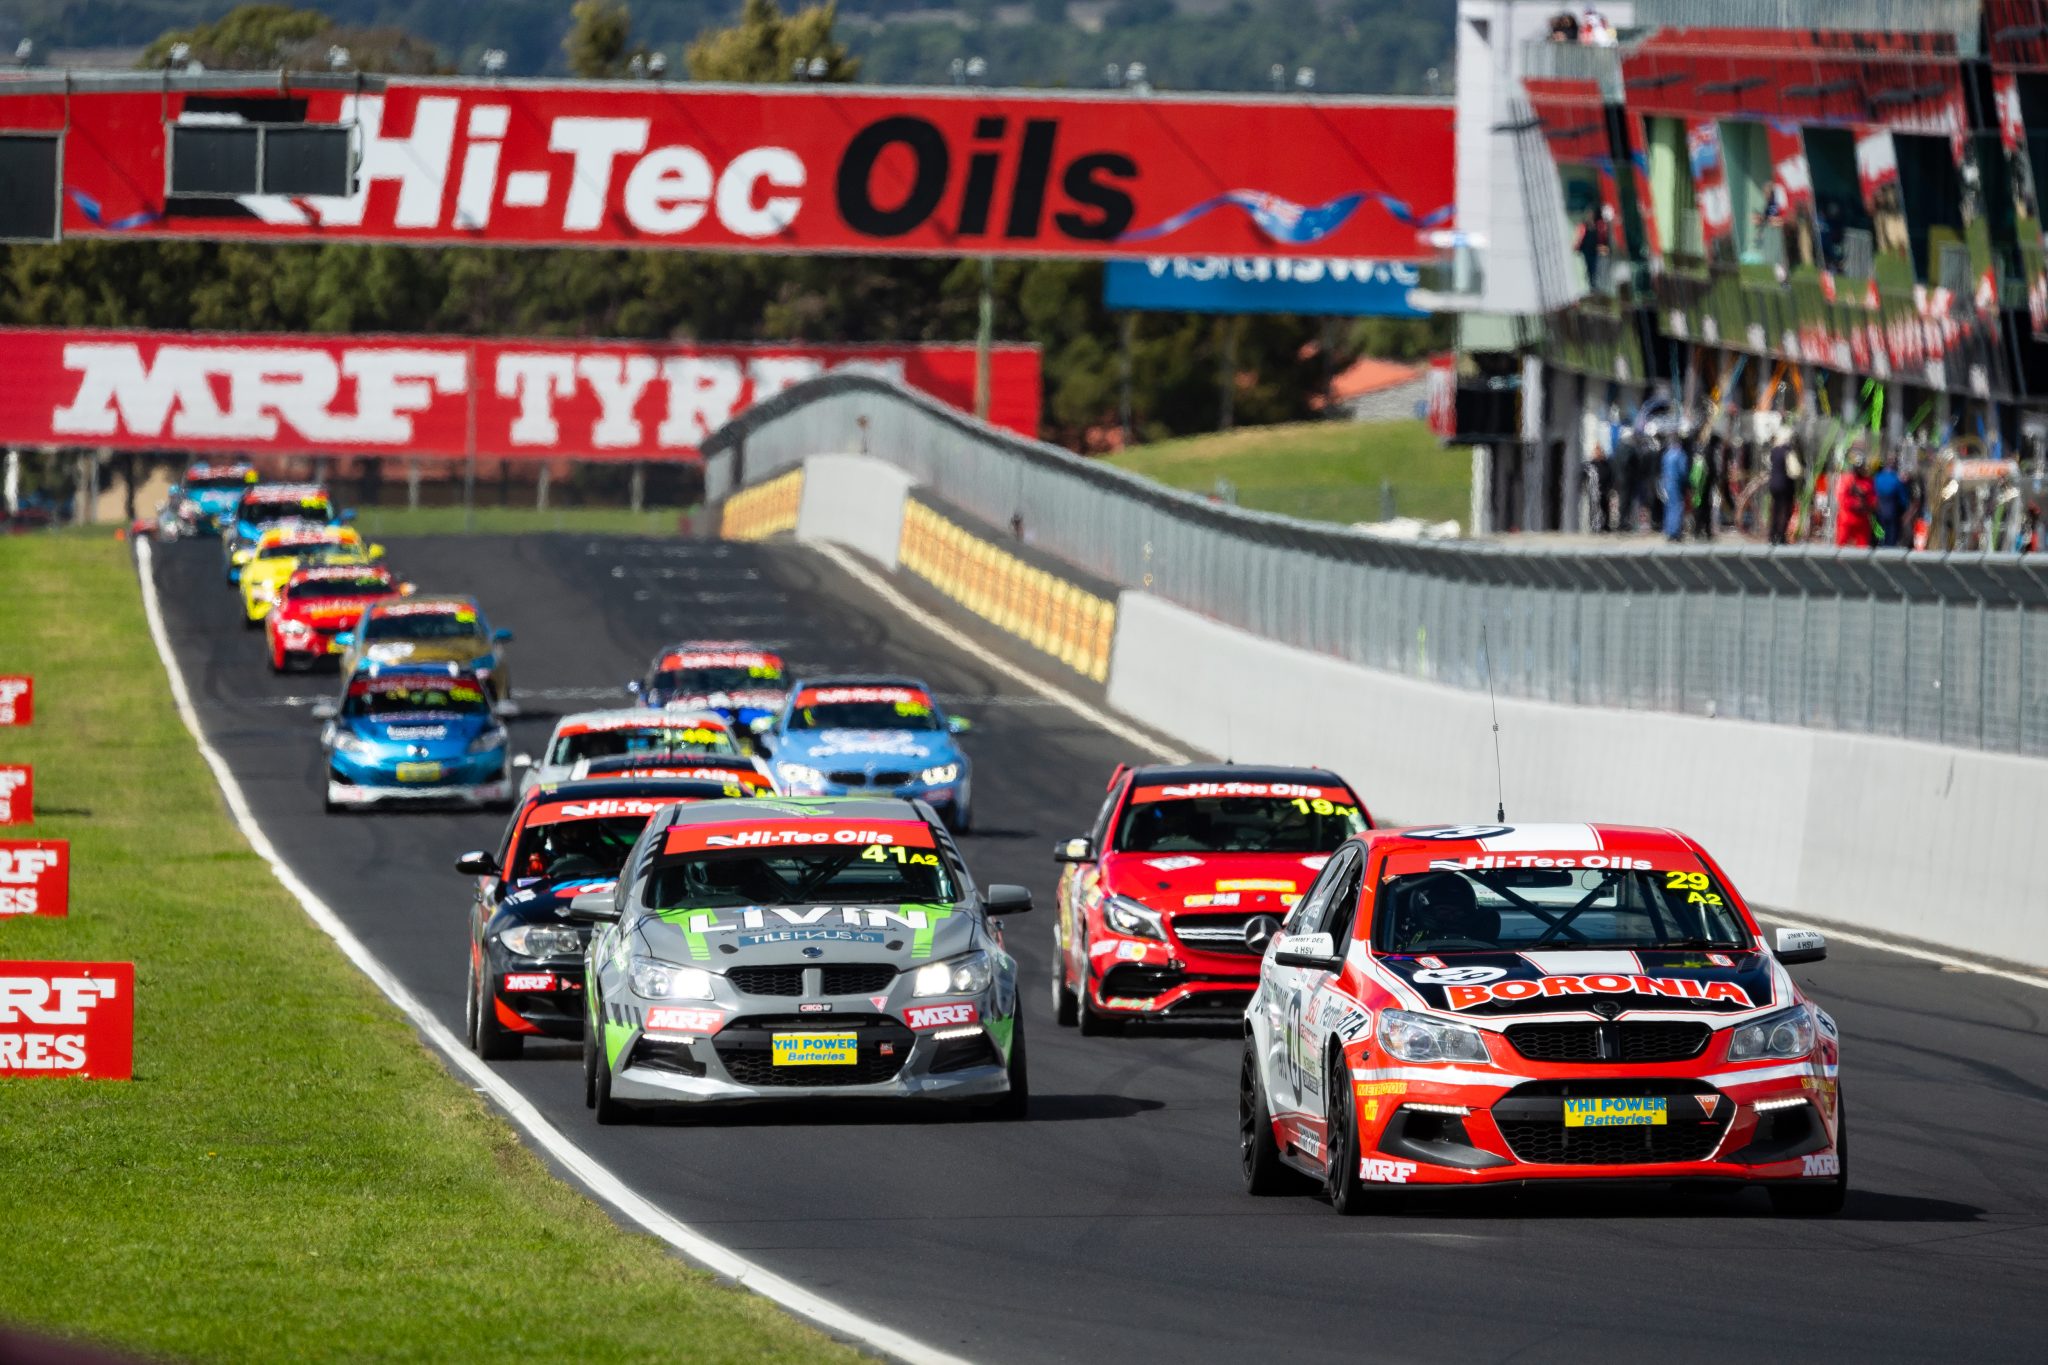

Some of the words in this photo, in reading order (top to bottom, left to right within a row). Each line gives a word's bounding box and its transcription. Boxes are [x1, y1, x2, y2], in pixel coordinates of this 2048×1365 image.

[325, 94, 806, 240] Hi-Tec
[836, 114, 1139, 242] Oils
[53, 342, 468, 444] MRF
[496, 353, 904, 448] TYR
[1187, 782, 1268, 796] Hi-Tec
[1270, 783, 1322, 798] Oils
[1292, 798, 1334, 816] 19
[736, 831, 830, 846] Hi-Tec
[833, 830, 894, 845] Oils
[862, 845, 908, 864] 41
[910, 853, 939, 866] A2
[1465, 855, 1576, 870] Hi-Tec
[1581, 856, 1653, 871] Oils
[1666, 871, 1710, 890] 29
[1688, 892, 1724, 906] A2
[689, 906, 929, 933] LIVIN
[1300, 946, 1314, 955] HSV
[506, 975, 553, 990] MRF
[1443, 974, 1757, 1010] BORONIA
[649, 1009, 721, 1030] MRF
[910, 1005, 975, 1027] MRF
[773, 1039, 799, 1050] YHI
[803, 1038, 857, 1050] POWER
[787, 1051, 845, 1061] Batteries
[1565, 1099, 1596, 1113] YHI
[1601, 1097, 1667, 1112] POWER
[1583, 1113, 1653, 1126] Batteries
[1359, 1157, 1417, 1184] MRF
